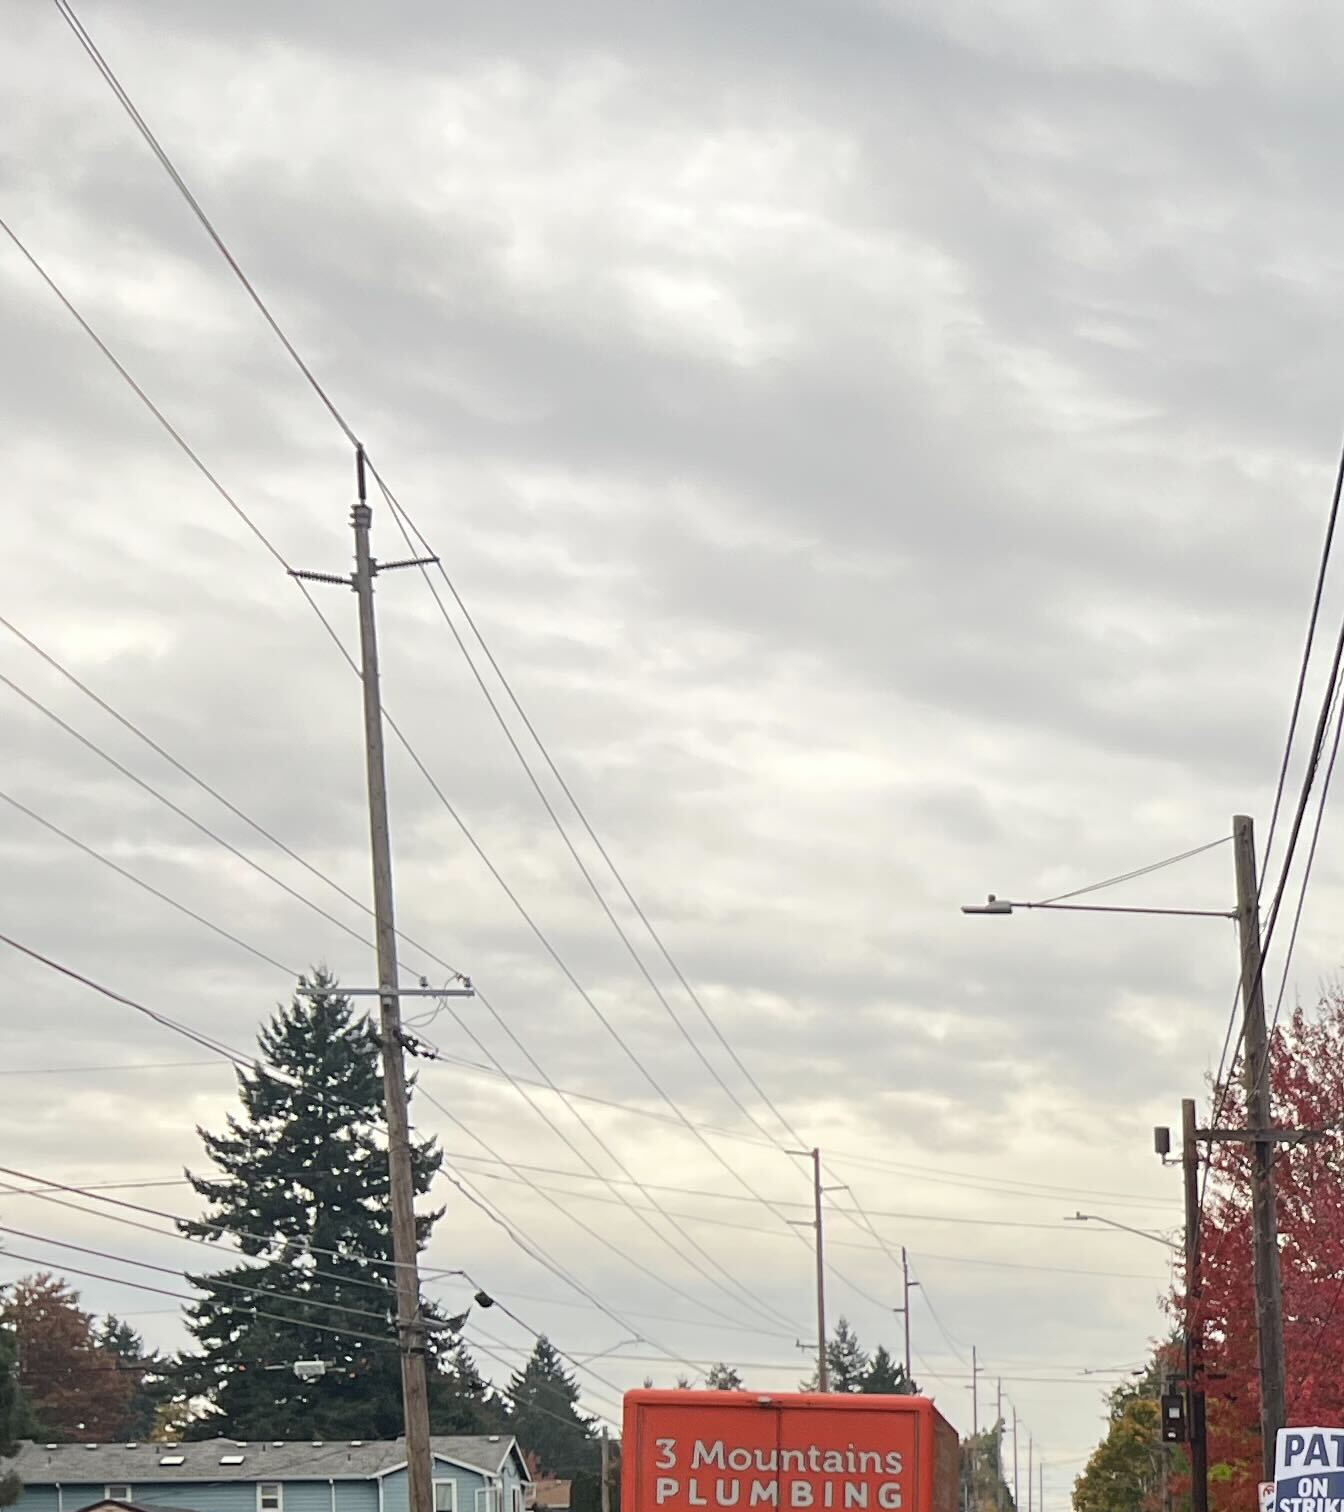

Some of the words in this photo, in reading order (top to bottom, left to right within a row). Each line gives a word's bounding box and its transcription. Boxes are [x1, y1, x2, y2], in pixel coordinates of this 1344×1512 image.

[655, 1438, 676, 1469] 3
[691, 1439, 903, 1475] Mountains
[656, 1477, 902, 1509] PLUMBING
[1298, 1478, 1328, 1497] ON
